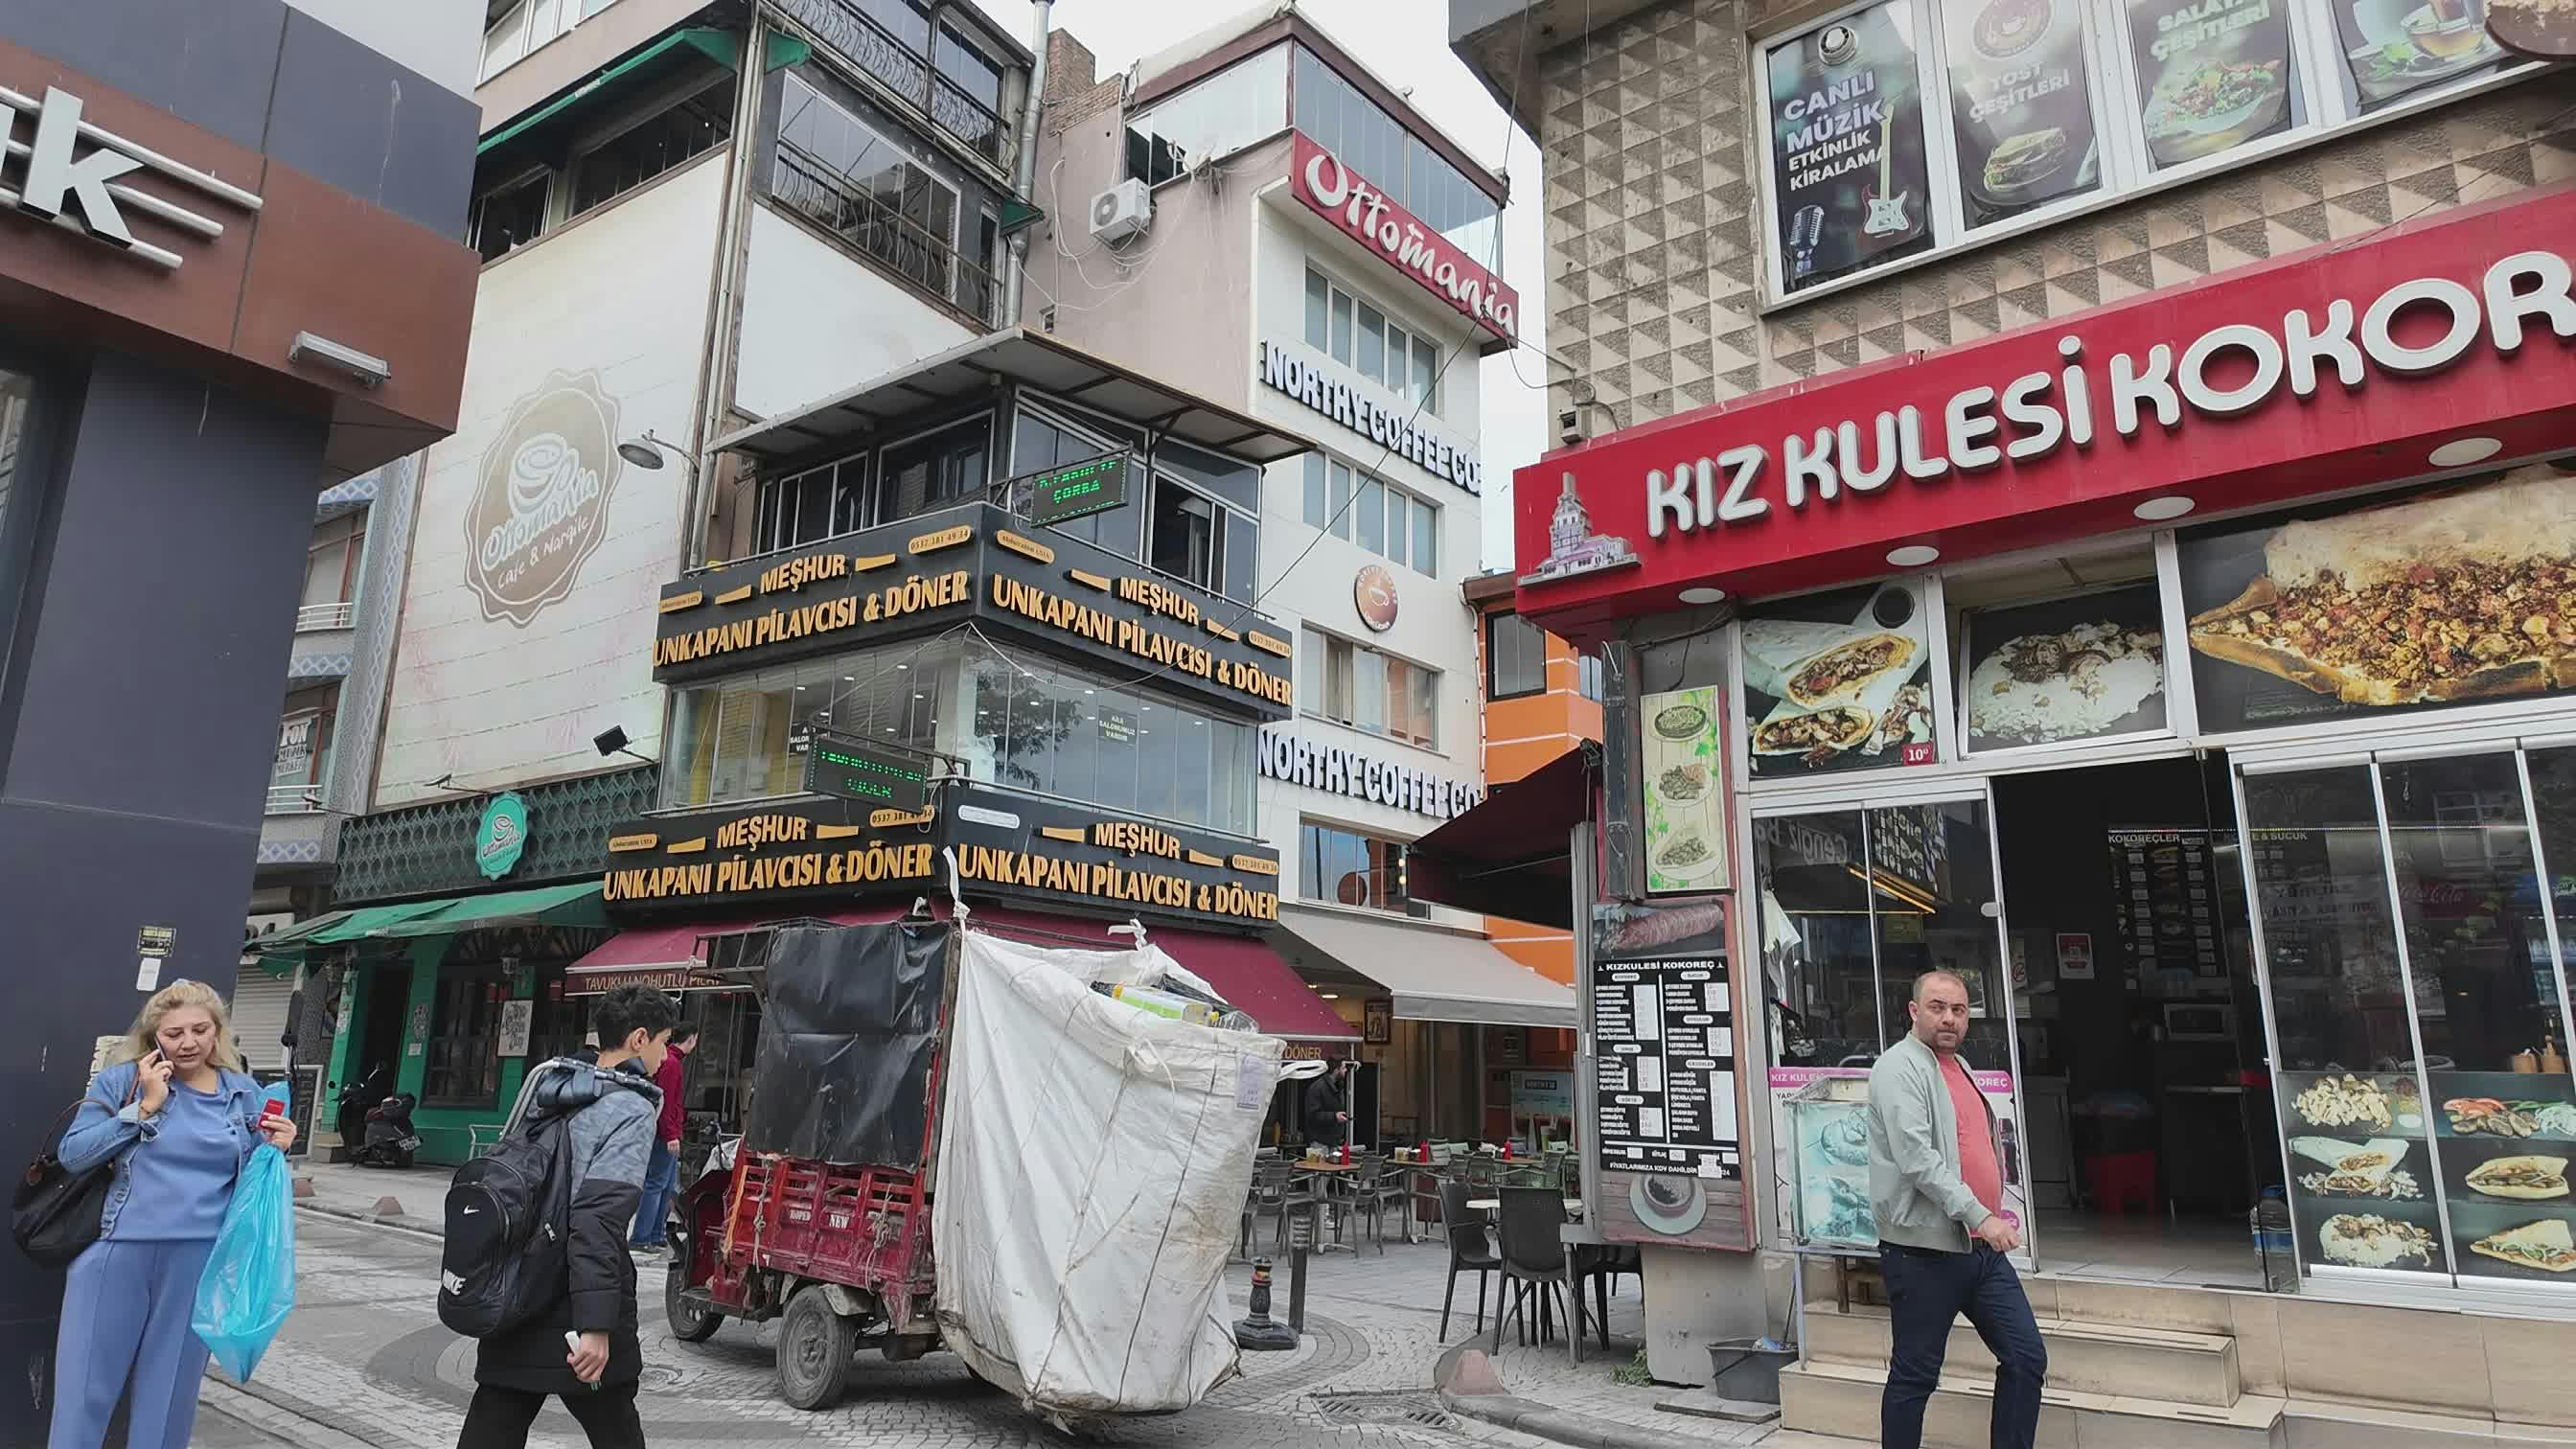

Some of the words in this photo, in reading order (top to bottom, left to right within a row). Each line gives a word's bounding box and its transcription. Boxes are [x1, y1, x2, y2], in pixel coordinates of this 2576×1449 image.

[1784, 70, 1874, 120] CANLI
[1987, 61, 2042, 91] TOST
[1786, 99, 1884, 153] MÜZİK
[0, 85, 145, 245] k
[1788, 130, 1871, 172] ETKİNLİK
[1305, 152, 1515, 336] Ottomania
[1646, 444, 1772, 538] KIZ
[1783, 335, 2093, 508] KULESİ
[2109, 251, 2576, 435] KOKOR
[1053, 479, 1100, 504] ÇORBA
[497, 564, 525, 589] Cafe
[529, 546, 540, 565] &
[543, 515, 589, 556] Nargile
[760, 554, 845, 594] MEŞHUR
[653, 619, 752, 667] UNKAPANI
[756, 596, 858, 645] PİLAVCISI
[863, 592, 883, 623] &
[886, 570, 970, 618] DÖNER
[1119, 577, 1200, 626] MEŞHUR
[993, 573, 1114, 645] UNKAPANI
[1118, 618, 1212, 678] PİLAVCISI
[1217, 658, 1230, 685] &
[1234, 659, 1293, 706] DÖNER
[717, 815, 807, 852] MEŞHUR
[1095, 822, 1181, 860] MEŞHUR
[2108, 834, 2180, 843] KOKOREÇLER
[2271, 832, 2308, 840] SUCUK
[603, 862, 711, 902] UNKAPANI
[717, 853, 822, 893] PİLAVCISI
[826, 857, 844, 885] &
[846, 840, 934, 882] DÖNER
[958, 843, 1088, 894] UNKAPANI
[1092, 860, 1191, 908] PİLAVCISI
[1197, 884, 1211, 912] &
[1215, 881, 1278, 921] DÖNER
[1606, 960, 1661, 971] KIZKULESİ
[1663, 960, 1715, 971] KOKOREÇ
[1285, 1045, 1322, 1060] DÖNER
[1771, 1073, 1787, 1082] KIZ
[829, 1214, 850, 1229] NEW
